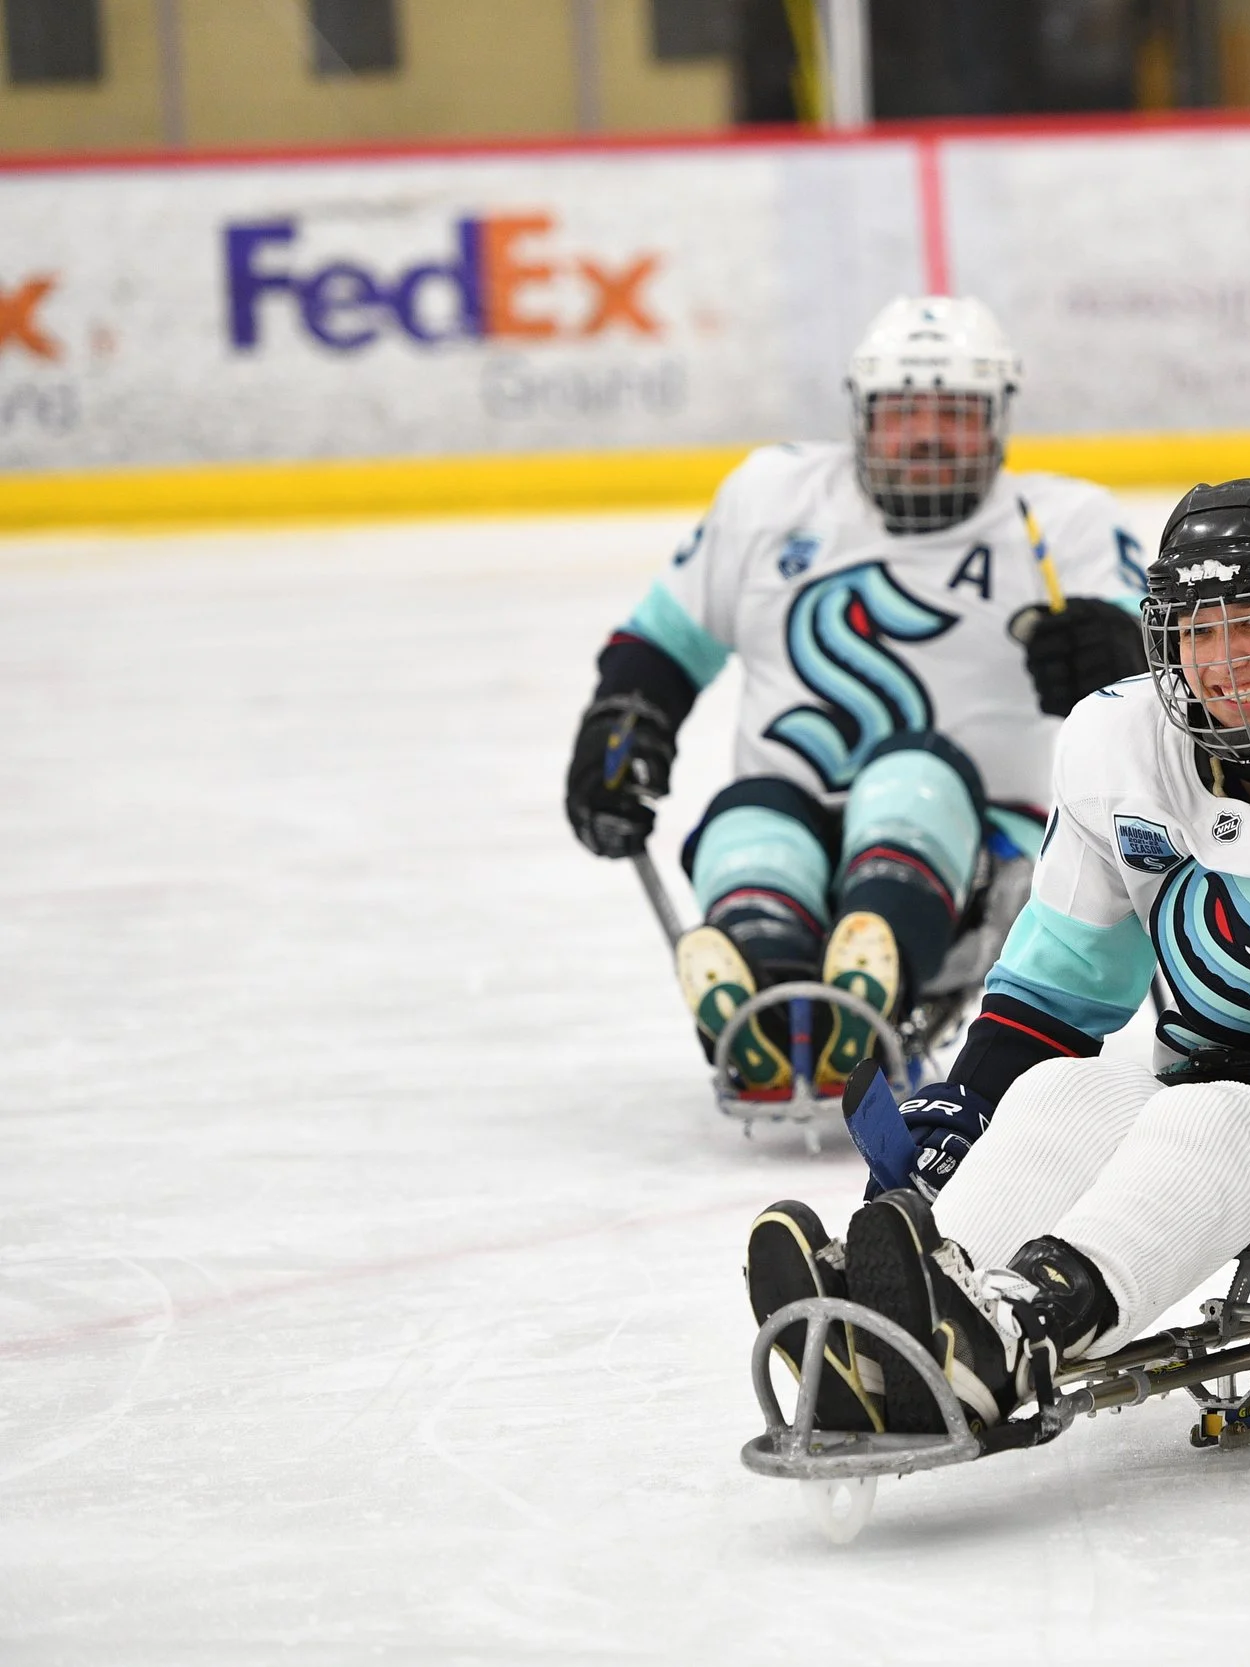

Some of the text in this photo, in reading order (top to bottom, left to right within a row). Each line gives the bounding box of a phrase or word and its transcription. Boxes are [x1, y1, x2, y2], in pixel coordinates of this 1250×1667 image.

[222, 212, 662, 352] FedEx
[948, 542, 992, 600] A
[1120, 825, 1166, 844] INAUGURAL
[1130, 844, 1164, 855] SEASON
[1238, 1407, 1247, 1418] G
